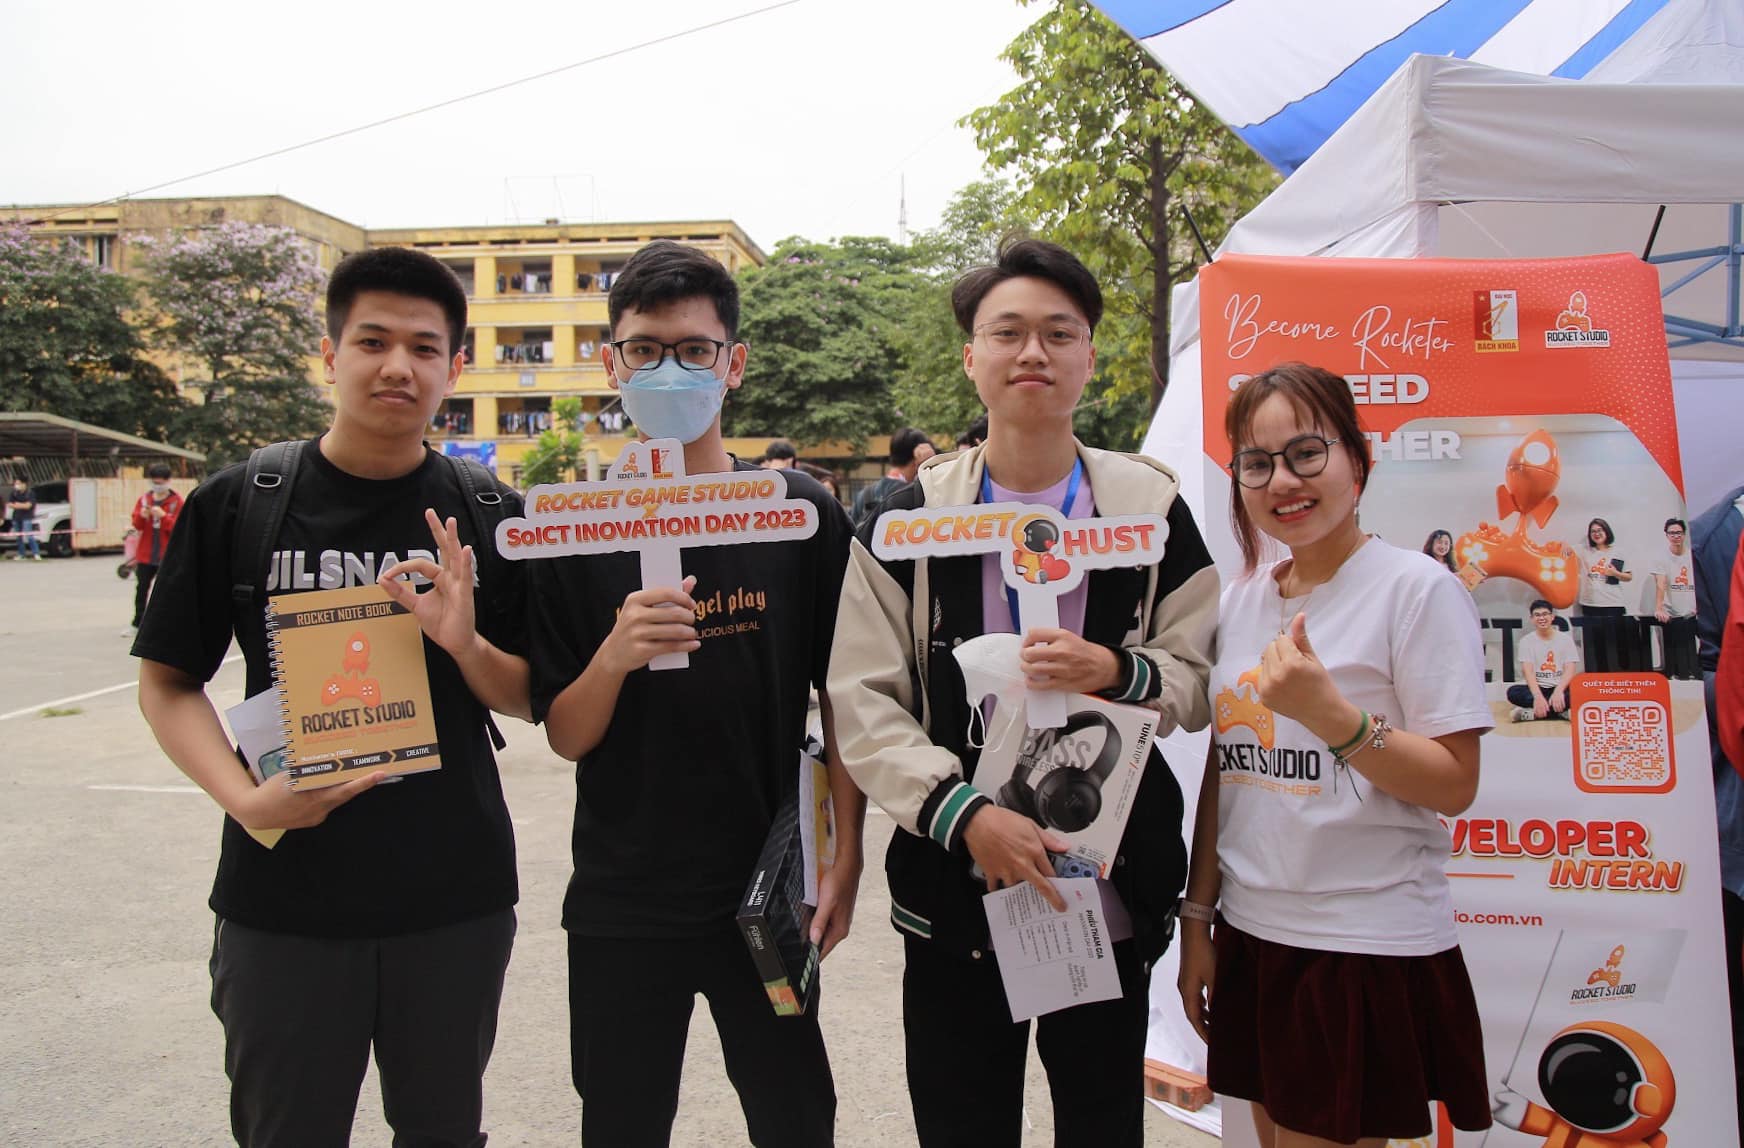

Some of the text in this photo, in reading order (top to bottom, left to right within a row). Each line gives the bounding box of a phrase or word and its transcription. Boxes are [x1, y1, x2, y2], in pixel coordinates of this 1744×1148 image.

[1224, 294, 1457, 370] Become Rocketer
[1547, 331, 1608, 342] ROCKET STUDIO
[534, 479, 776, 513] ROCKET GAME STUDIO
[506, 509, 807, 547] SoICT INOVATION DAY 2023
[883, 511, 1155, 556] ROCKET HUST
[296, 602, 393, 626] ROCKET NOTE BOOK
[728, 586, 766, 616] play
[697, 624, 735, 639] LICIOUS
[301, 708, 360, 735] ROCKET
[364, 699, 416, 725] STUDIO
[406, 747, 430, 757] CREATIVE
[1022, 728, 1091, 770] BASS
[1216, 744, 1320, 780] CKET STUDIO
[1440, 818, 1649, 857] VELOPER
[1548, 859, 1682, 890] INTERN
[1454, 909, 1543, 927] io.com.vn
[1571, 987, 1605, 1000] ROCKET
[1606, 984, 1637, 996] STUDIO
